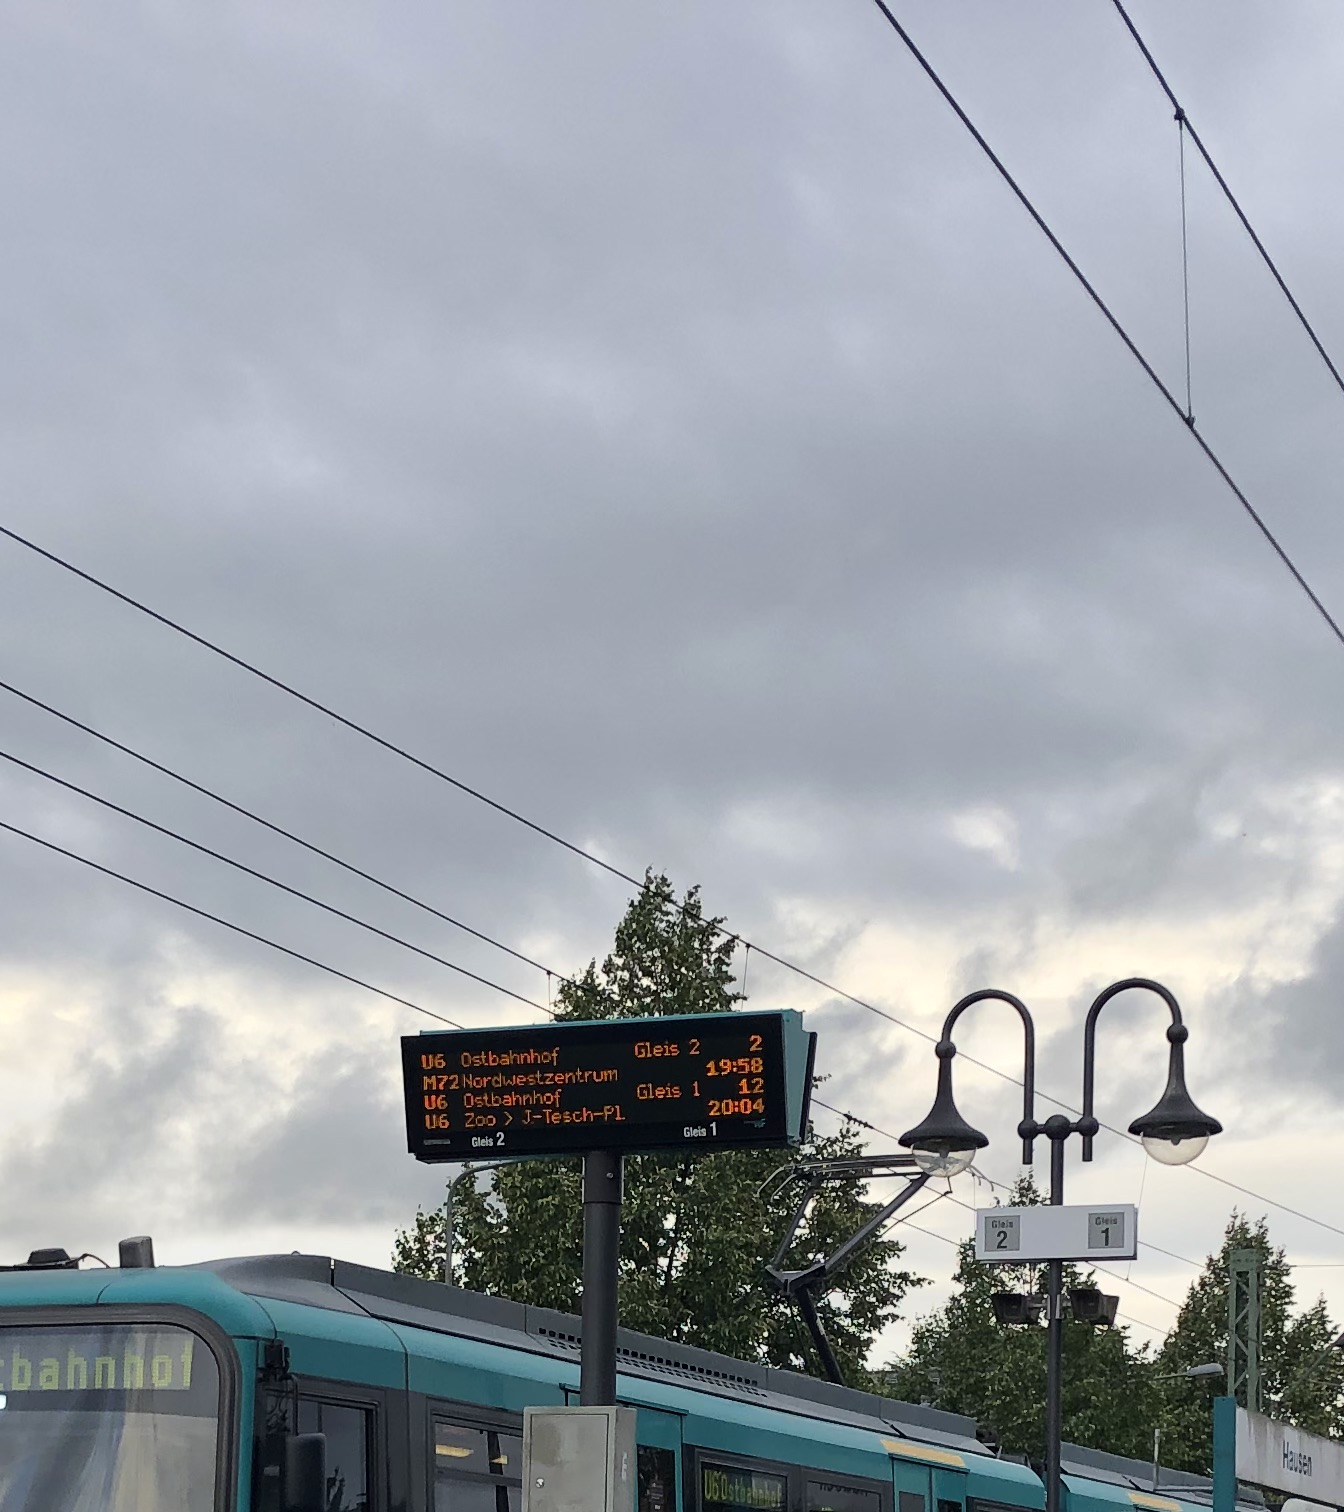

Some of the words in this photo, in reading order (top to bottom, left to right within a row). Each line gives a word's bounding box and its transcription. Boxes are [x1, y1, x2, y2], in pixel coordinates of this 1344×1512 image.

[420, 1053, 446, 1070] U6
[460, 1047, 560, 1067] Ostbahnhof
[634, 1040, 680, 1058] Gleis
[689, 1038, 700, 1055] 2
[749, 1034, 763, 1052] 2
[423, 1074, 459, 1091] M72
[463, 1066, 618, 1089] Nordwestzentrum
[706, 1057, 764, 1076] 19:58
[424, 1094, 448, 1110] U6
[463, 1088, 562, 1108] Ostbahnhof
[636, 1082, 682, 1099] Gleis
[692, 1080, 701, 1097] 1
[738, 1077, 764, 1094] 12
[425, 1113, 450, 1129] U6
[464, 1112, 497, 1128] Zoo
[708, 1098, 765, 1116] 20:04
[471, 1134, 494, 1147] Gleis
[496, 1131, 505, 1146] 2
[683, 1125, 706, 1138] Gleis
[710, 1121, 717, 1136] 1
[991, 1219, 1013, 1229] Gleis
[1095, 1216, 1118, 1226] Gleis
[996, 1230, 1008, 1249] 2
[1101, 1227, 1110, 1247] 1
[1282, 1440, 1312, 1476] Hausen
